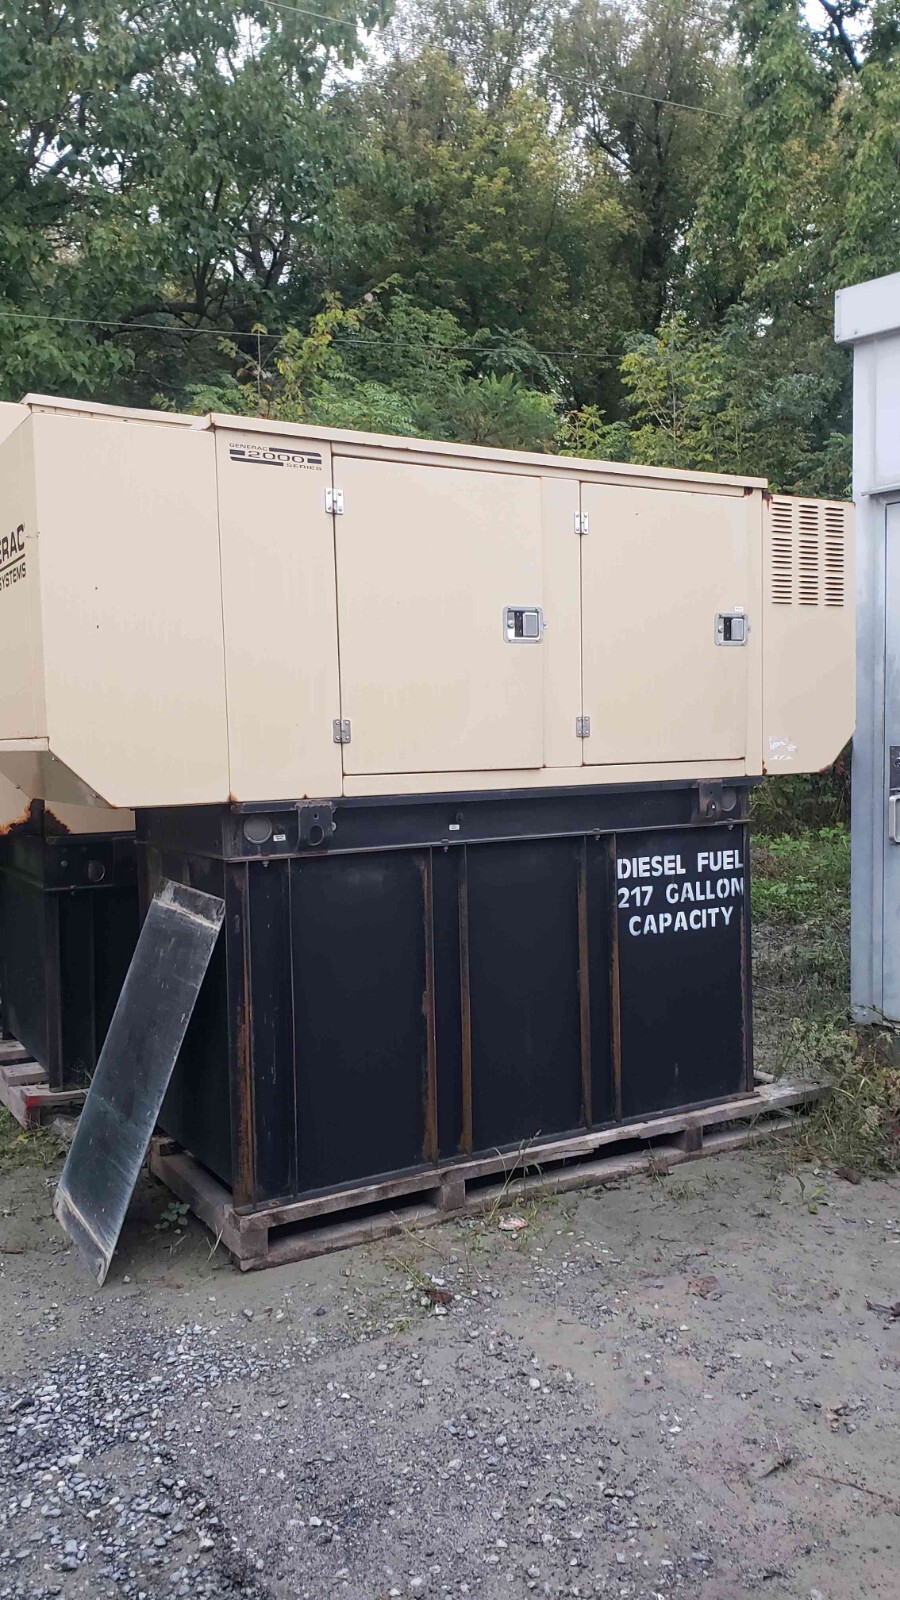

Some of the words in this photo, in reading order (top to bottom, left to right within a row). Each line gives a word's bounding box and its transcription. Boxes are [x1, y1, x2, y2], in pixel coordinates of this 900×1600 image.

[229, 442, 268, 452] GENERAC
[248, 450, 305, 463] 2000
[286, 463, 322, 471] SERIES
[0, 523, 25, 564] RAC
[617, 854, 686, 879] DIESEL
[697, 849, 743, 873] FUEL
[617, 885, 654, 909] 217
[665, 877, 744, 904] GALLON
[628, 906, 734, 937] CAPACITY
